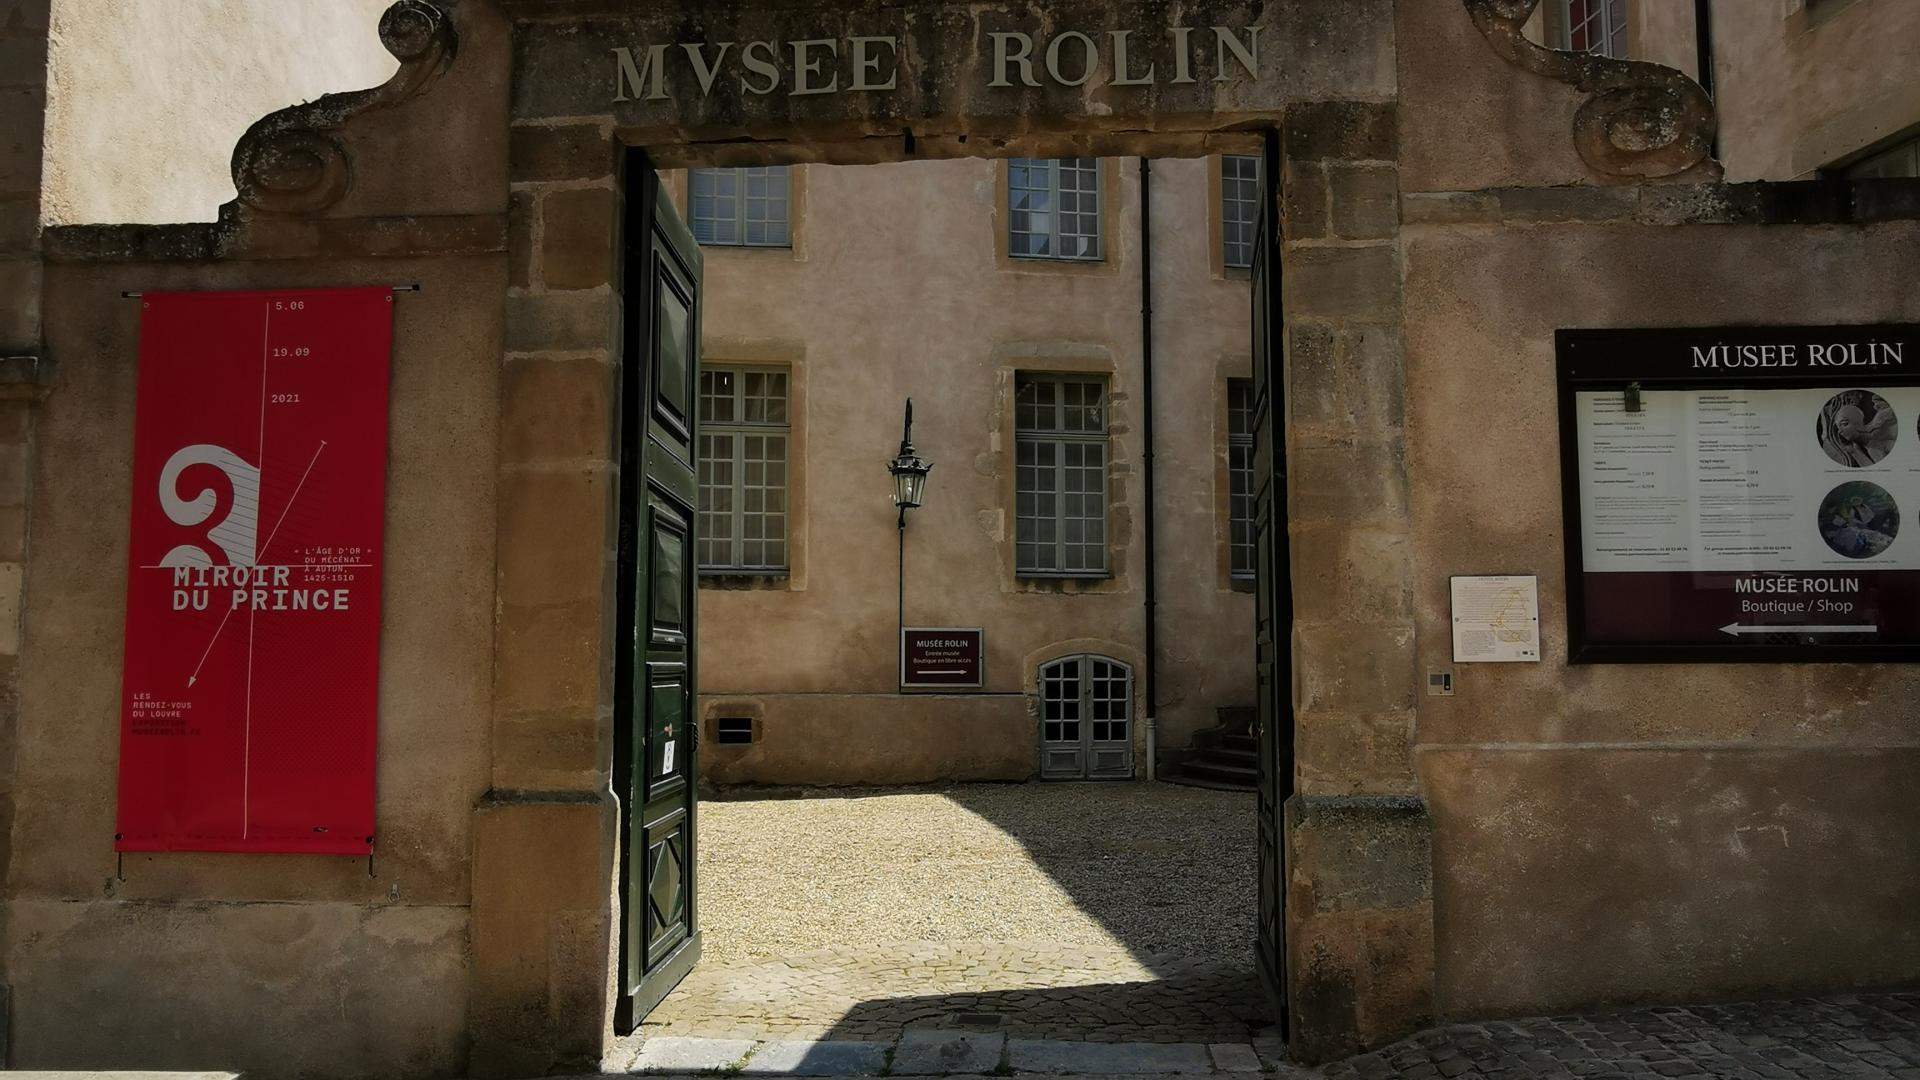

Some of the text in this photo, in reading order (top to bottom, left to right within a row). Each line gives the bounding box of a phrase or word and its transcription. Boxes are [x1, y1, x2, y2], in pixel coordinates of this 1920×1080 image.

[611, 26, 1264, 102] MVSEE ROLIN
[276, 301, 305, 311] 5.06
[273, 347, 310, 357] 19.09
[1691, 343, 1904, 368] MUSEE ROLIN
[272, 394, 300, 403] 2021
[174, 566, 290, 587] MIROIR
[1735, 575, 1859, 593] MUSÉE ROLIN
[173, 589, 350, 611] DU PRINCE
[1742, 600, 1804, 615] Boutique
[1817, 600, 1854, 615] Shop
[916, 639, 969, 648] MUSÉE ROLIN
[133, 692, 151, 700] LES
[133, 701, 192, 709] RENDEZ-VOUS
[132, 710, 182, 718] DU LOUVRE
